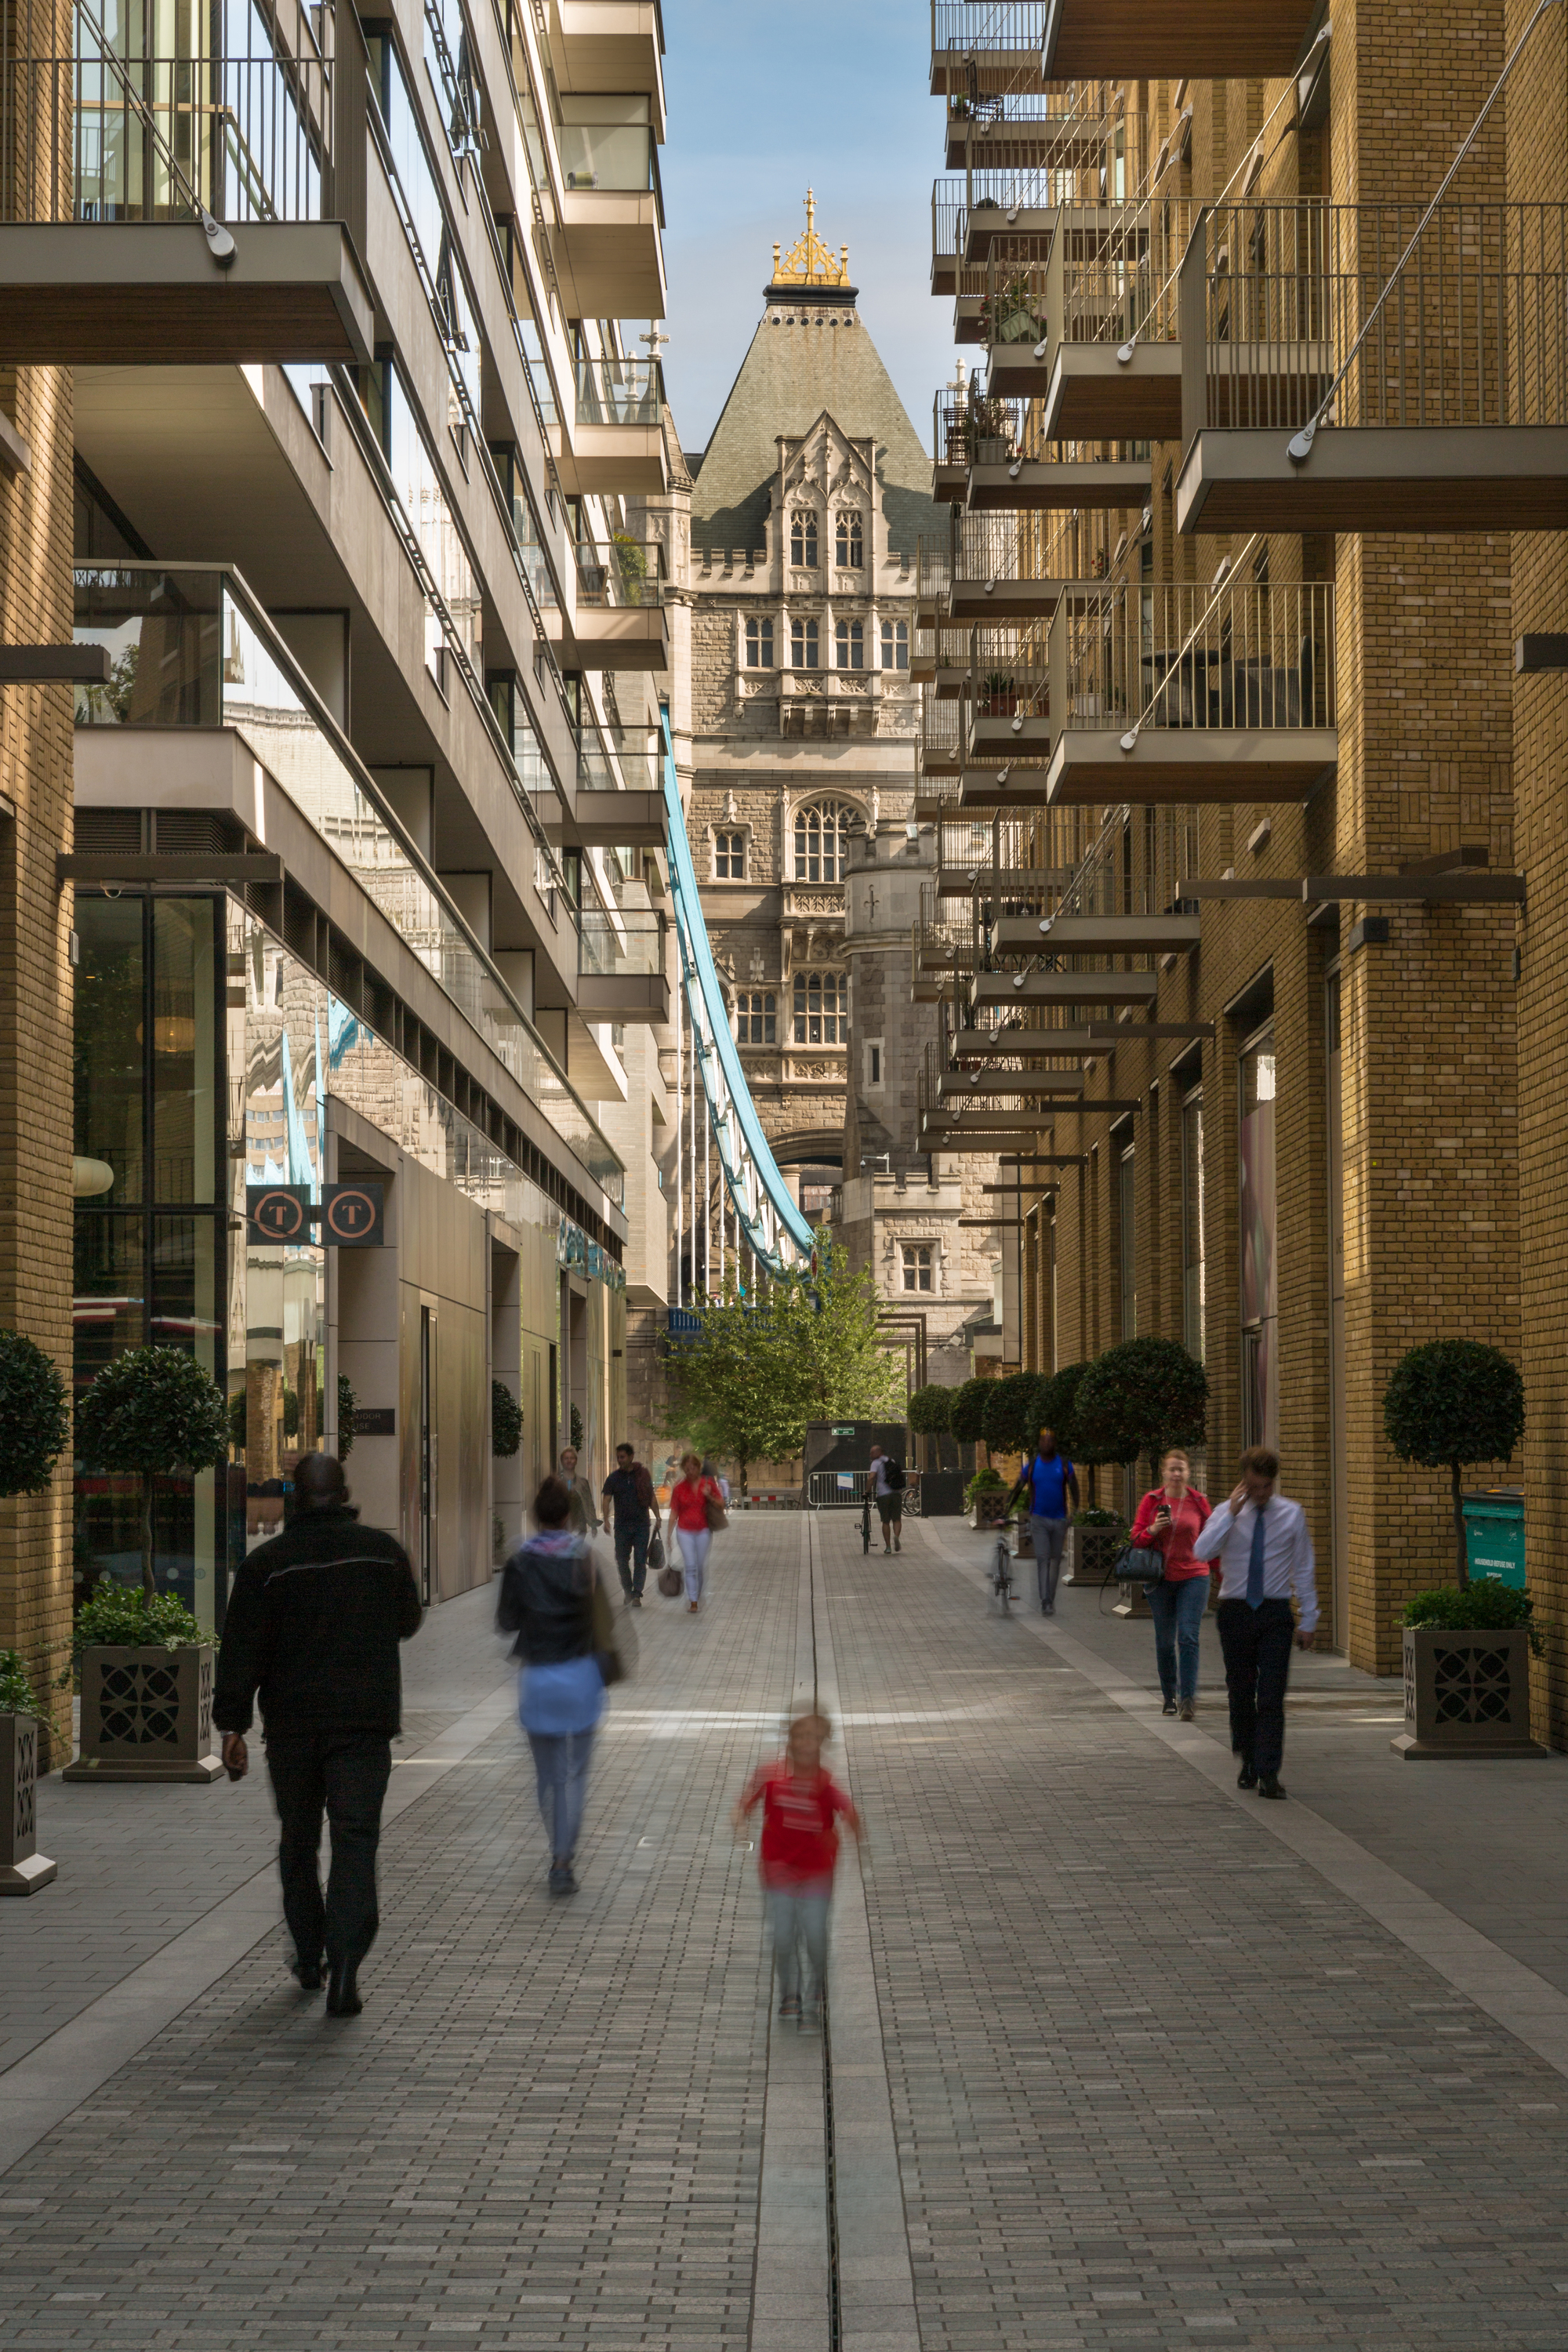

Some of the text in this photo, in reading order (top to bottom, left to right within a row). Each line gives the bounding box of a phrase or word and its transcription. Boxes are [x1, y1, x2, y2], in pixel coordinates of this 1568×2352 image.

[342, 1205, 361, 1225] T
[1475, 1558, 1494, 1566] HOUSEHOLD
[1494, 1559, 1506, 1568] REFUSE
